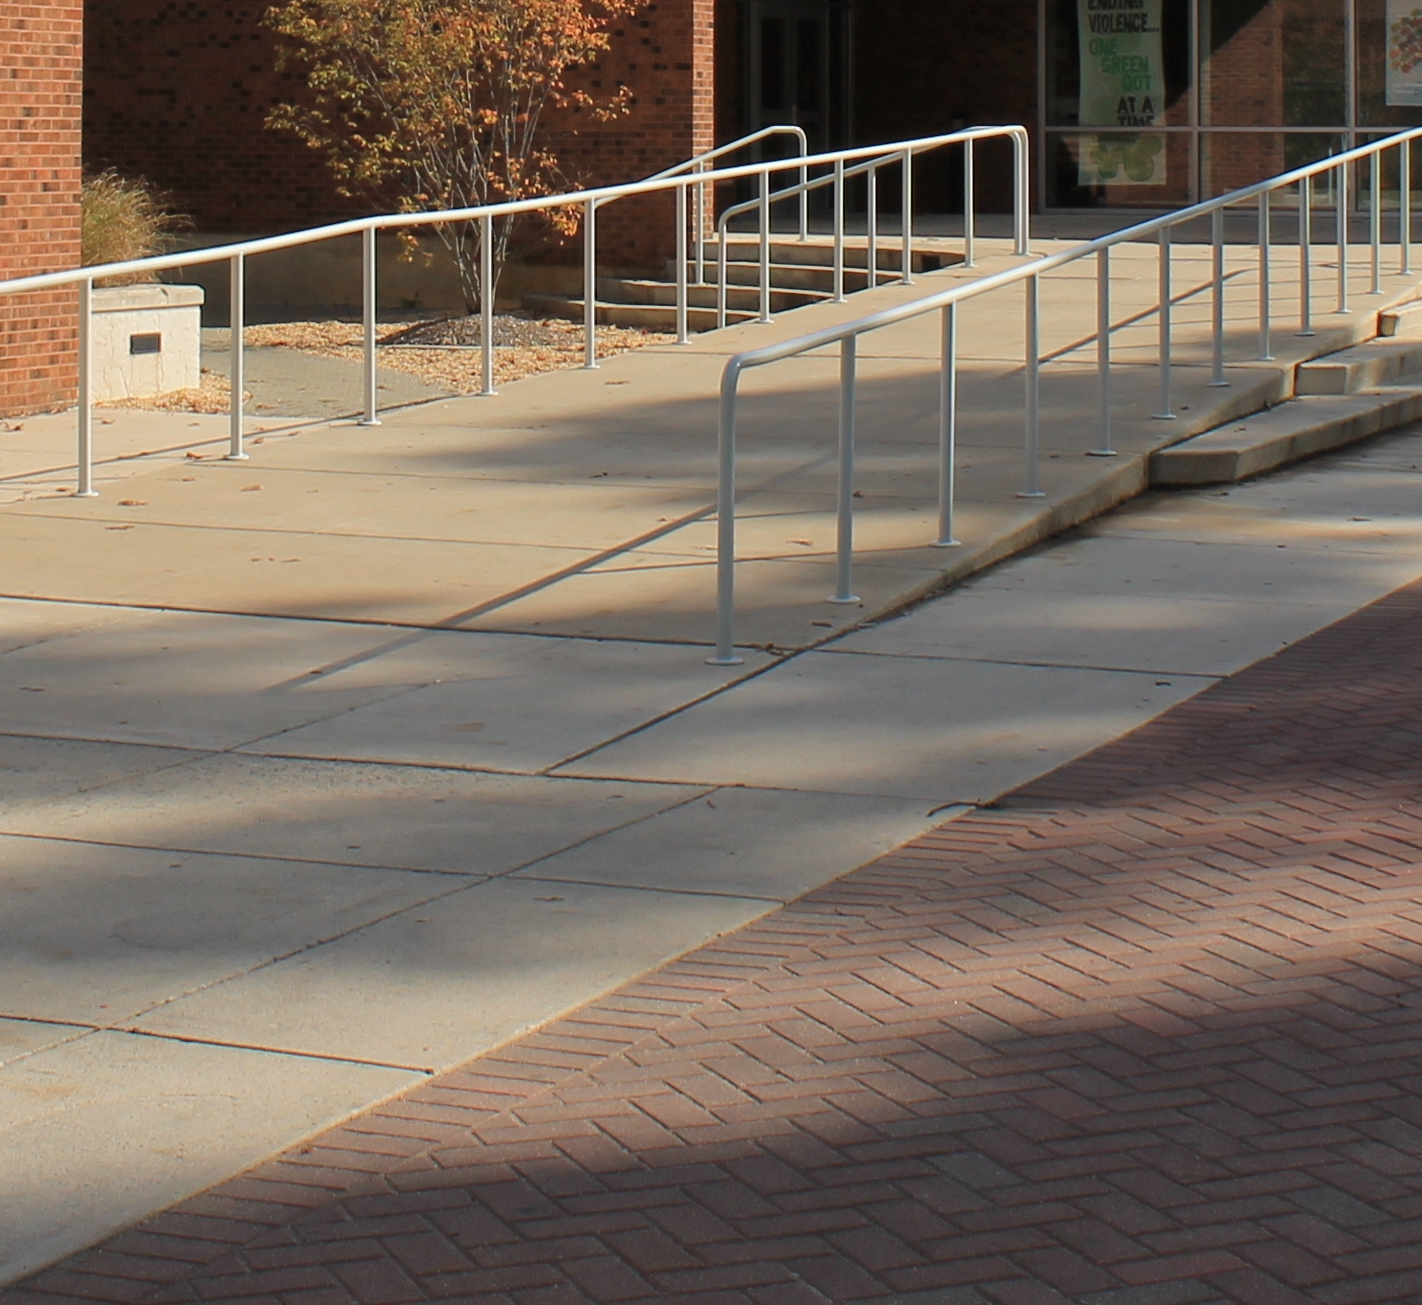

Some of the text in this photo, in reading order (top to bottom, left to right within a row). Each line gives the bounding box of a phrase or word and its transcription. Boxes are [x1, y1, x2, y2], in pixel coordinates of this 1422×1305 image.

[1088, 12, 1159, 33] VIOLENCE...
[1088, 38, 1118, 56] ONE
[1100, 56, 1150, 74] GREEN
[1121, 73, 1153, 92] DOT
[1116, 96, 1155, 115] AT A
